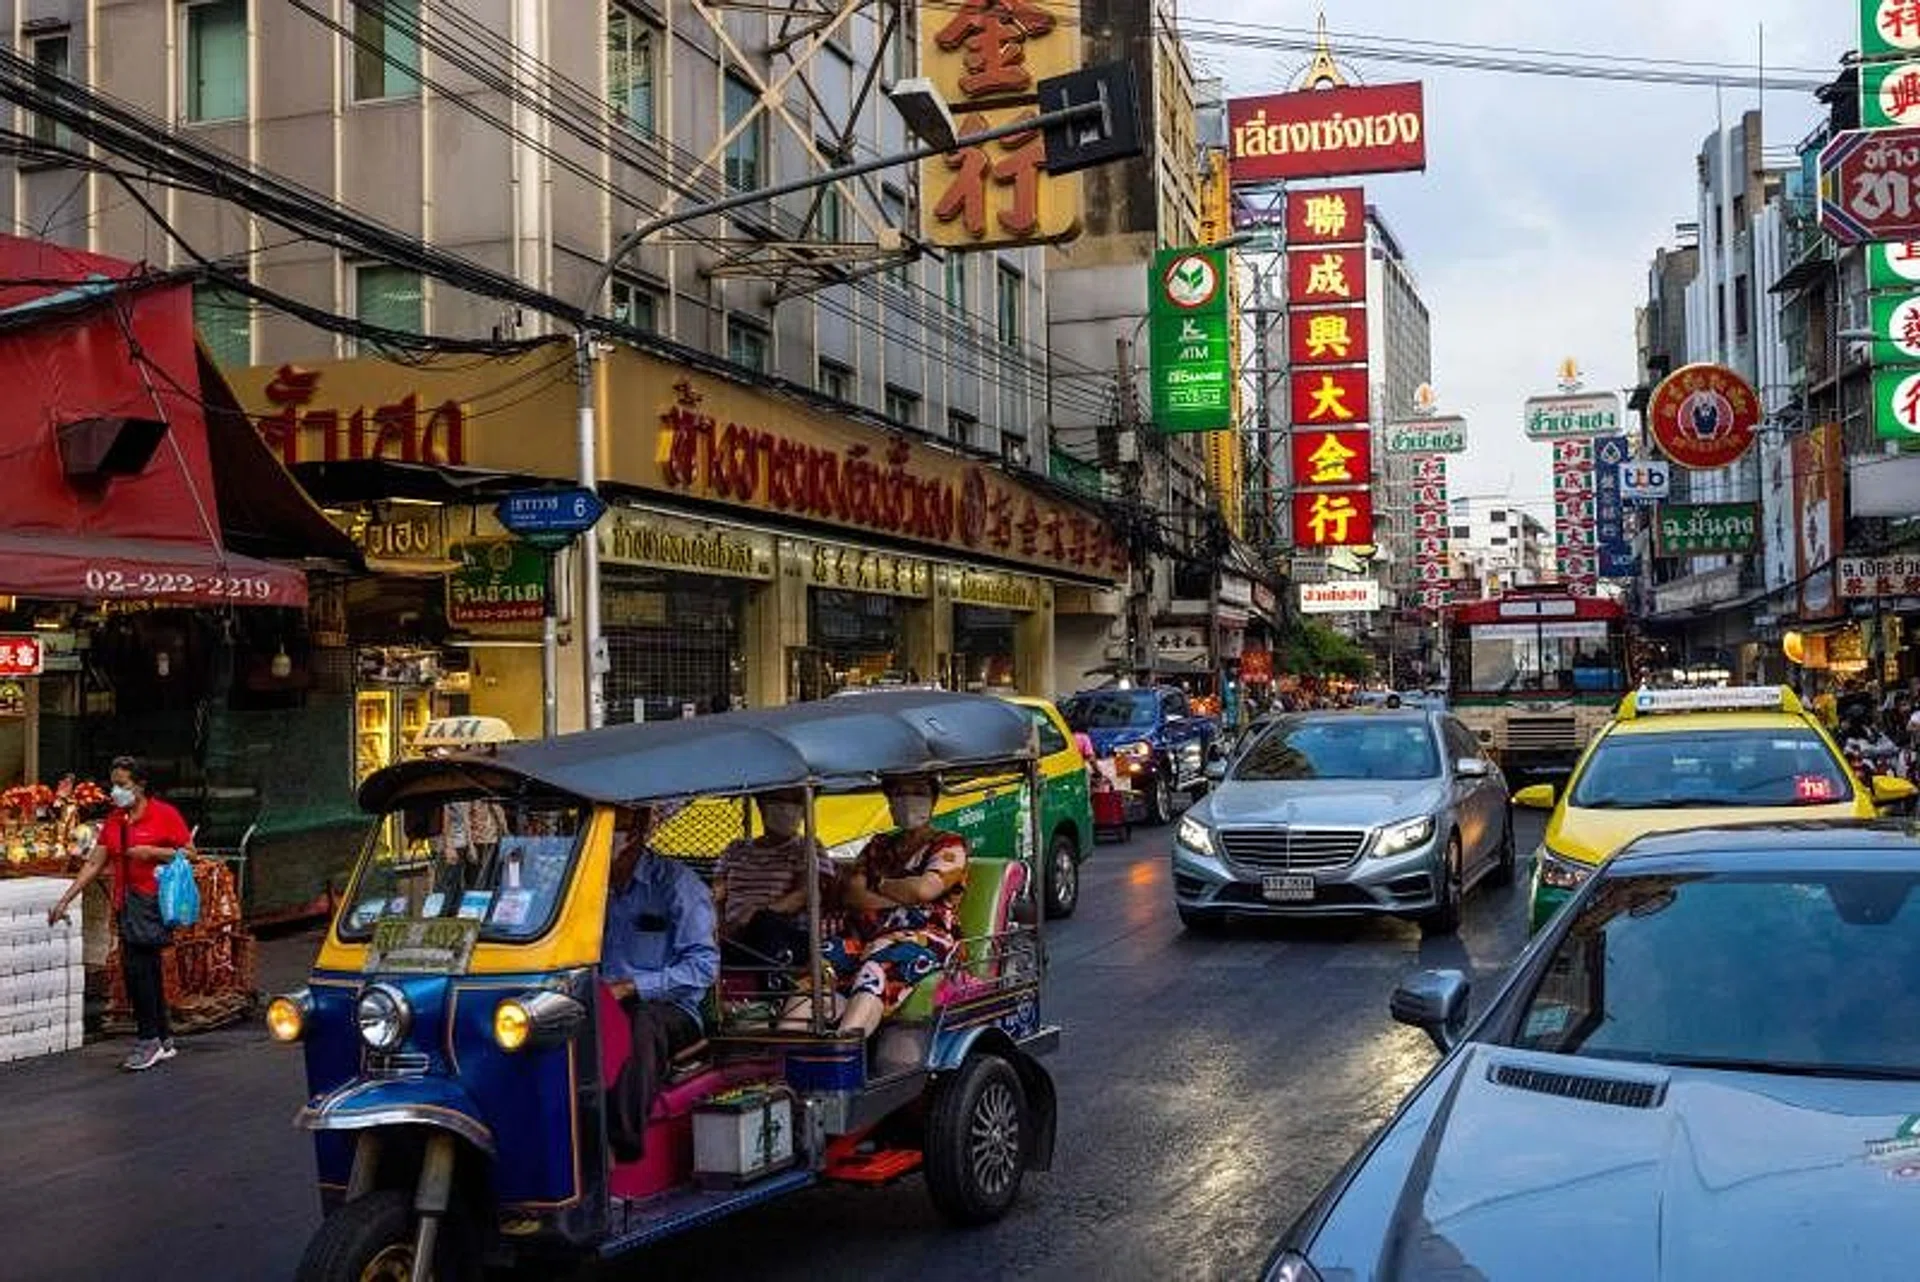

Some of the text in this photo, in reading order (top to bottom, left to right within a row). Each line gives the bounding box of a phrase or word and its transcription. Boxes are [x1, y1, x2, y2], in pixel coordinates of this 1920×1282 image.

[1235, 110, 1420, 158] เลี่ยงเซ่งเฮง
[1306, 197, 1358, 543] 聯成興大金行
[1624, 468, 1665, 488] ttb
[573, 497, 587, 518] 6
[86, 569, 270, 599] 02-222-2219
[424, 720, 481, 738] TAXI
